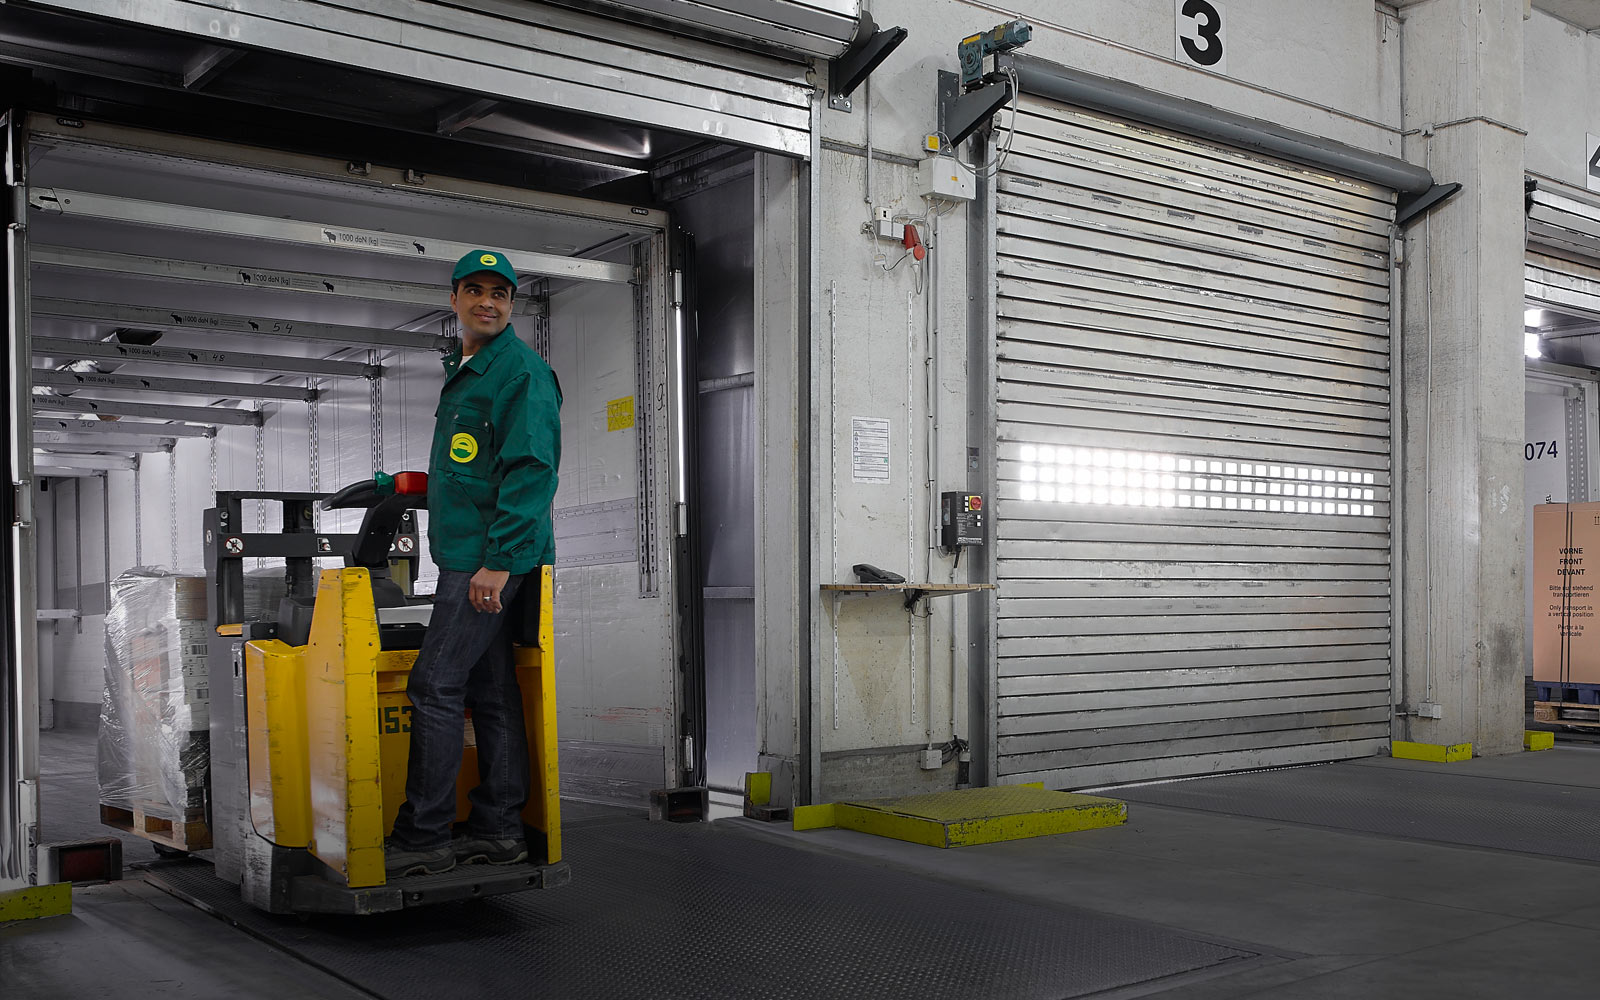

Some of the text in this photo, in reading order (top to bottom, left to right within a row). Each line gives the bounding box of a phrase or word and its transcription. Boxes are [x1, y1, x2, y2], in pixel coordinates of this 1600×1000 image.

[1179, 0, 1224, 66] 3
[339, 233, 354, 242] 1000
[1524, 440, 1558, 460] 074
[1559, 547, 1584, 555] VORNE
[1557, 568, 1586, 576] DEVANT
